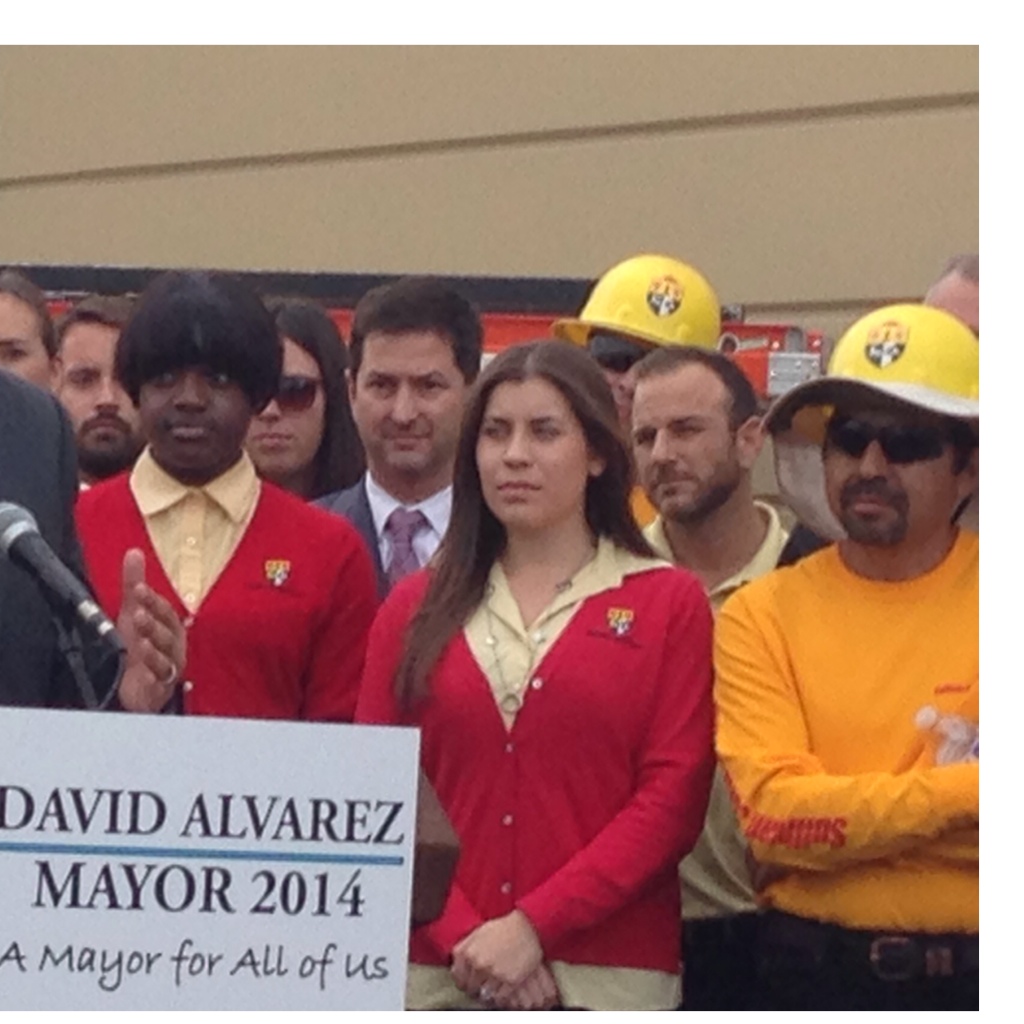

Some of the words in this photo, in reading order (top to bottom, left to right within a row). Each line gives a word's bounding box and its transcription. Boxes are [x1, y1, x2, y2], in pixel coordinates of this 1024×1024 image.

[180, 794, 404, 844] ALVAREZ
[31, 860, 236, 914] MAYOR
[249, 869, 365, 917] 2014
[38, 944, 162, 992] Mayor
[171, 939, 223, 986] for
[229, 945, 289, 977] All
[298, 944, 337, 990] of
